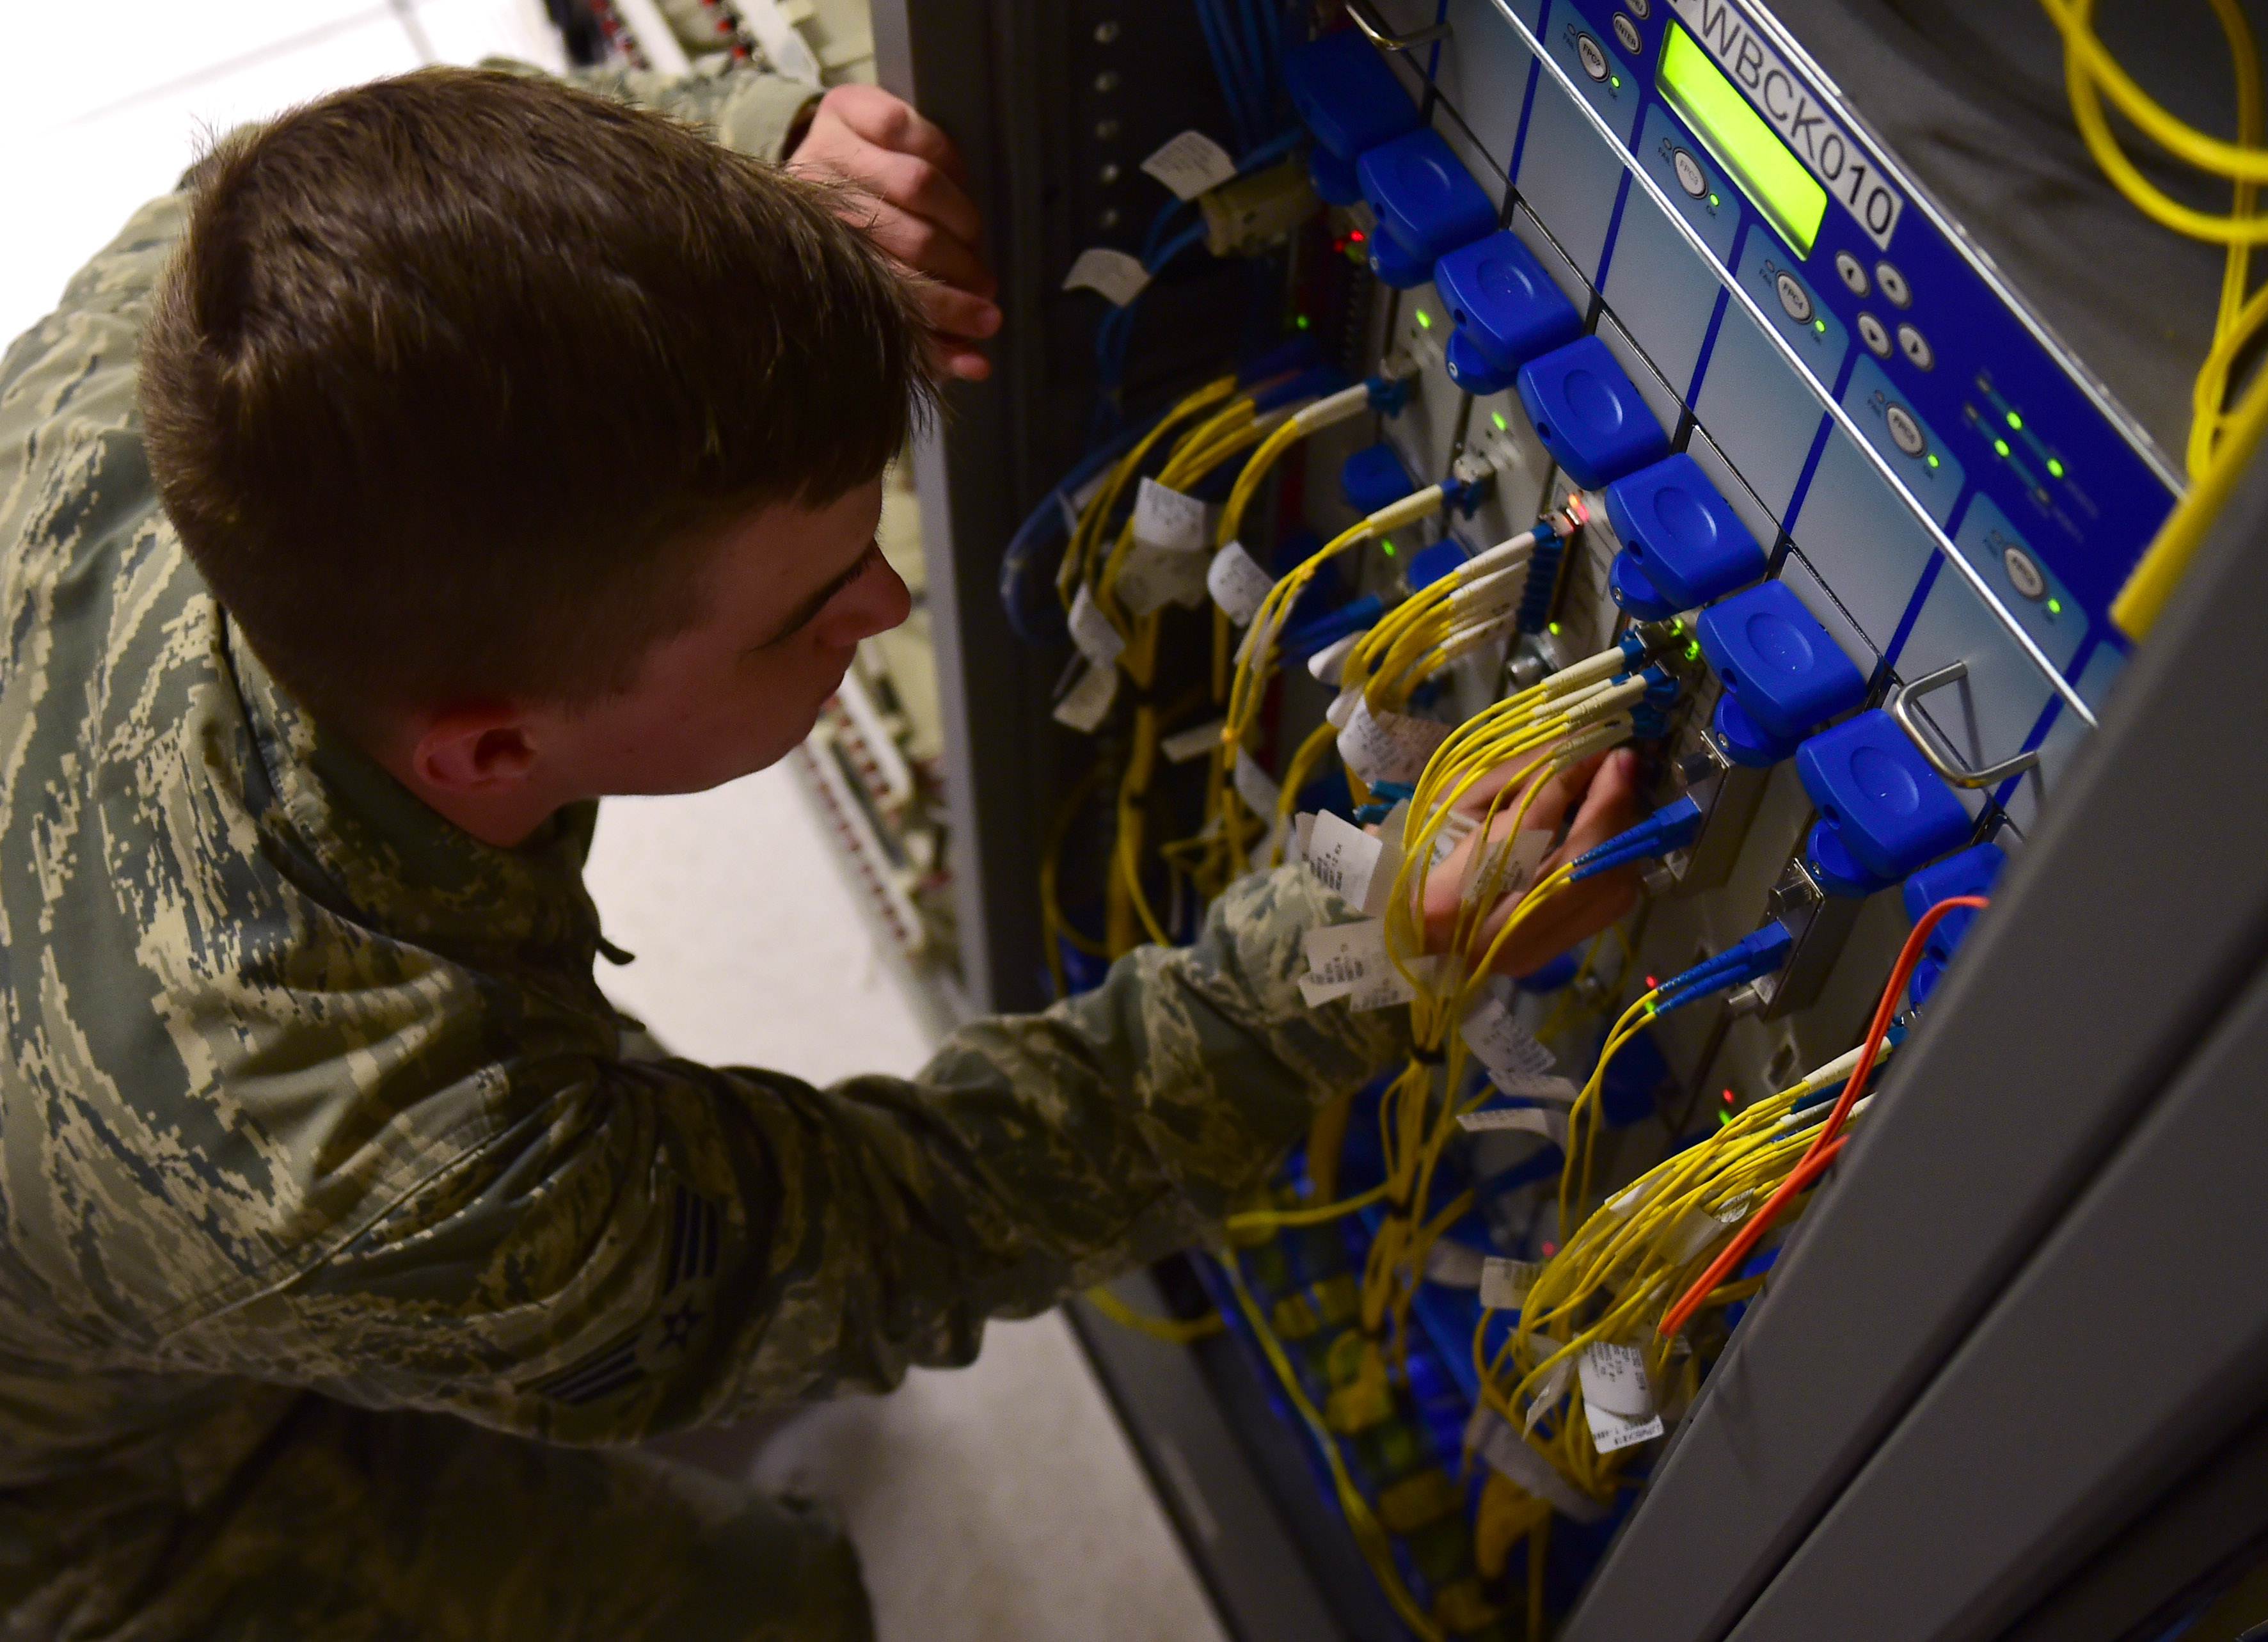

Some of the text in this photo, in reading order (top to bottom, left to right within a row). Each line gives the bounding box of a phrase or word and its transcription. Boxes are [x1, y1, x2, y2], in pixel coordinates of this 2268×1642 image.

[1615, 20, 1636, 48] ENTER
[1583, 44, 1601, 66] FPC2
[1674, 0, 1894, 235] WBCK010
[1680, 160, 1699, 185] FPC3
